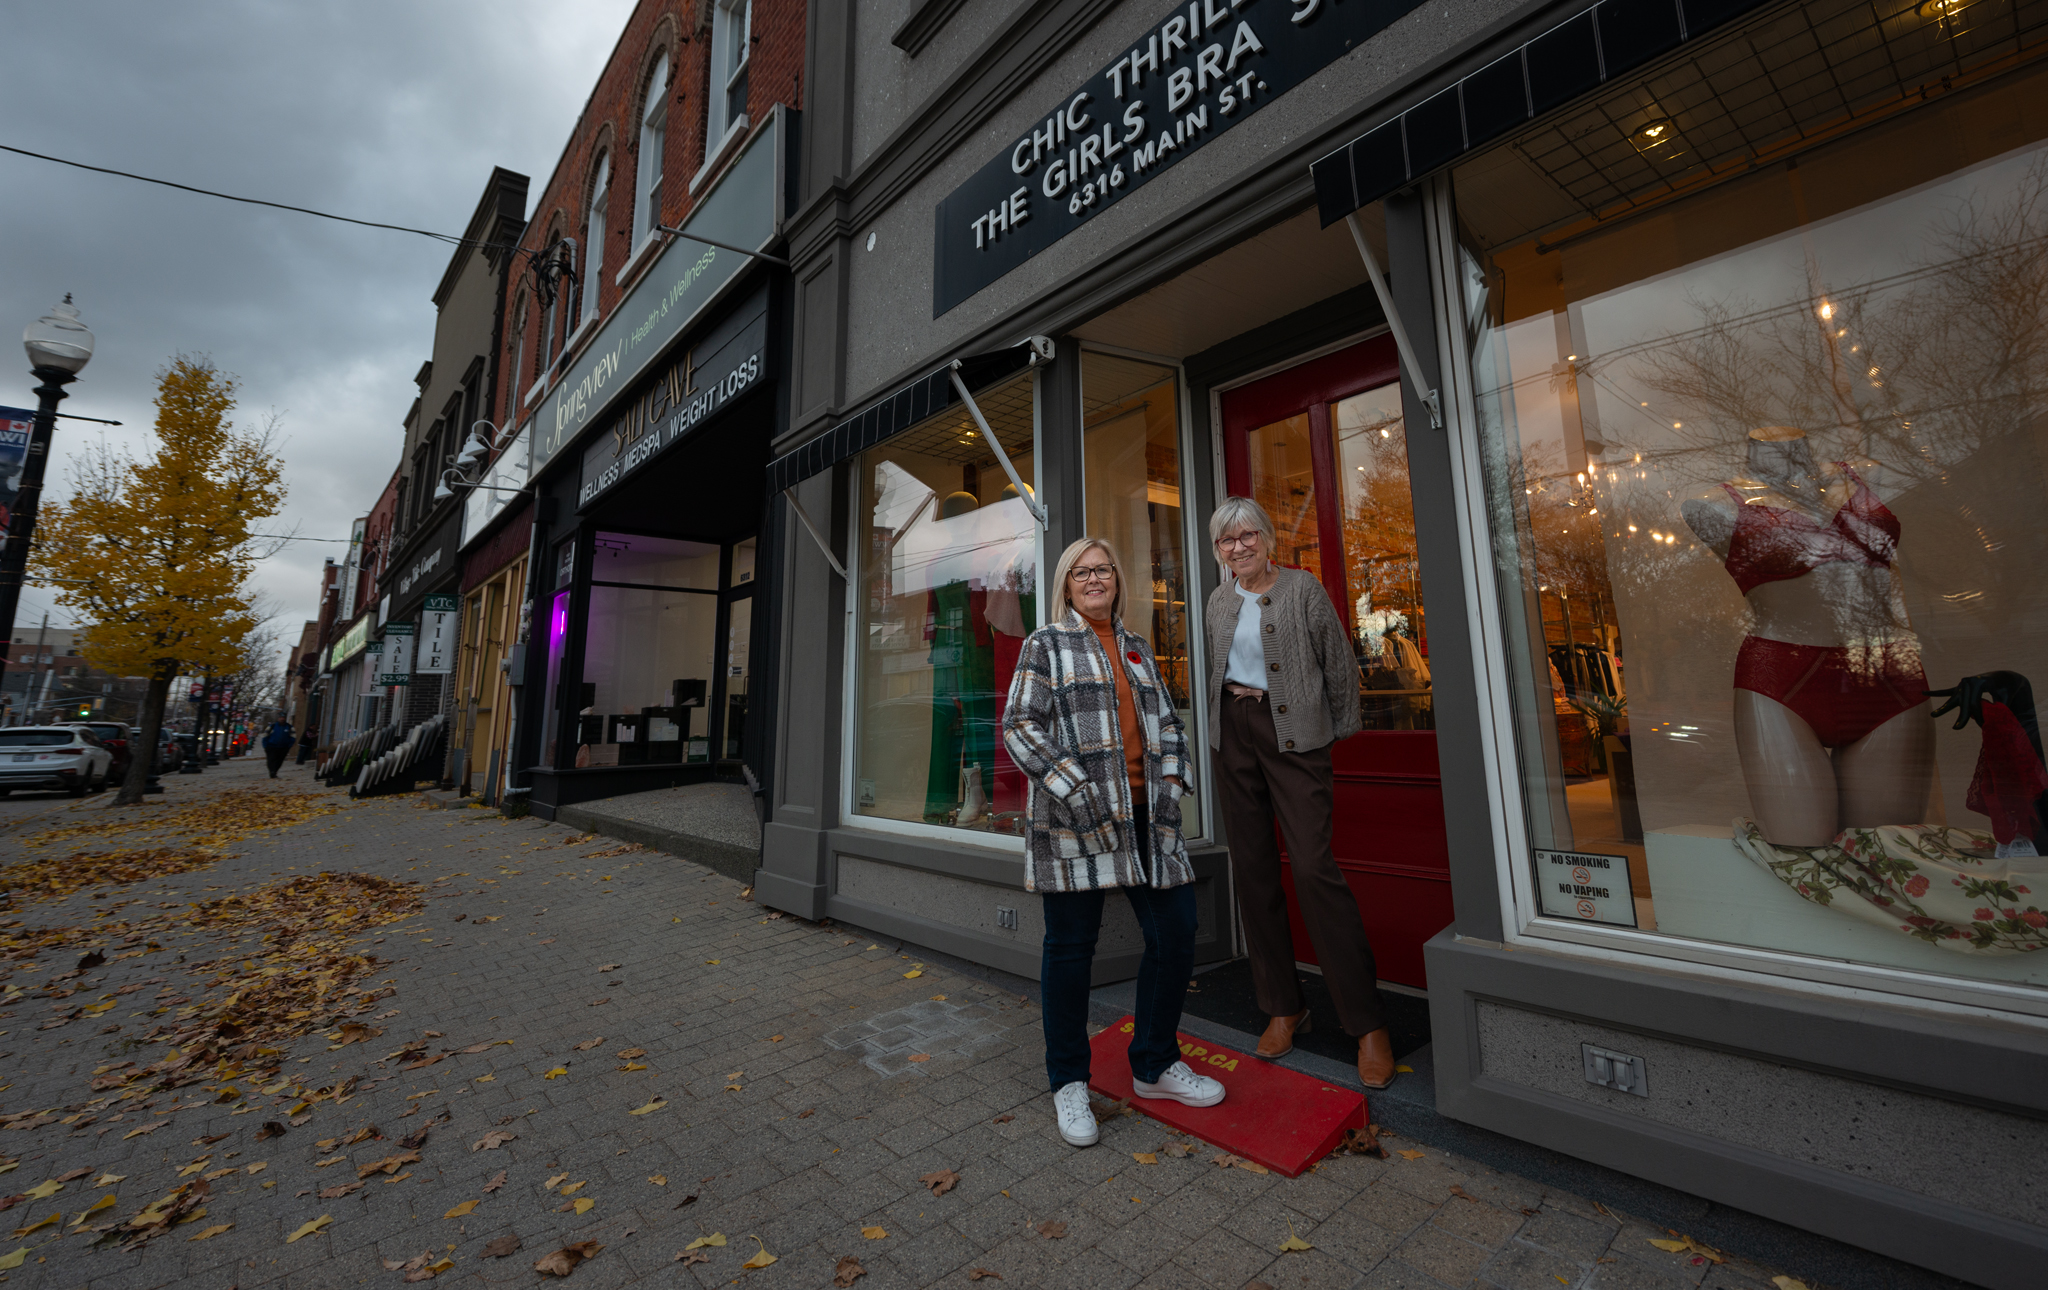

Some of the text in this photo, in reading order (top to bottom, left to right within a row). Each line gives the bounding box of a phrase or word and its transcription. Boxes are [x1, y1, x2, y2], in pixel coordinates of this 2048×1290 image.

[1011, 0, 1242, 175] CHIC THRIL
[970, 20, 1264, 250] THE GIRLS BRA
[1068, 70, 1267, 215] 6316 MAIN ST.
[546, 245, 716, 454] Springview Health & Wellness
[611, 342, 699, 458] SALT CAVE
[579, 354, 758, 506] WELLNESS MEDSPA WEIGHT LOSS
[430, 597, 453, 608] VTC
[1350, 571, 1421, 589] SHOP LOCAL
[393, 636, 403, 673] SALE
[430, 613, 446, 668] TILE
[370, 654, 382, 692] TILE
[1550, 854, 1610, 869] NO SMOKING
[1558, 883, 1572, 894] NO
[1573, 884, 1610, 898] VAPING
